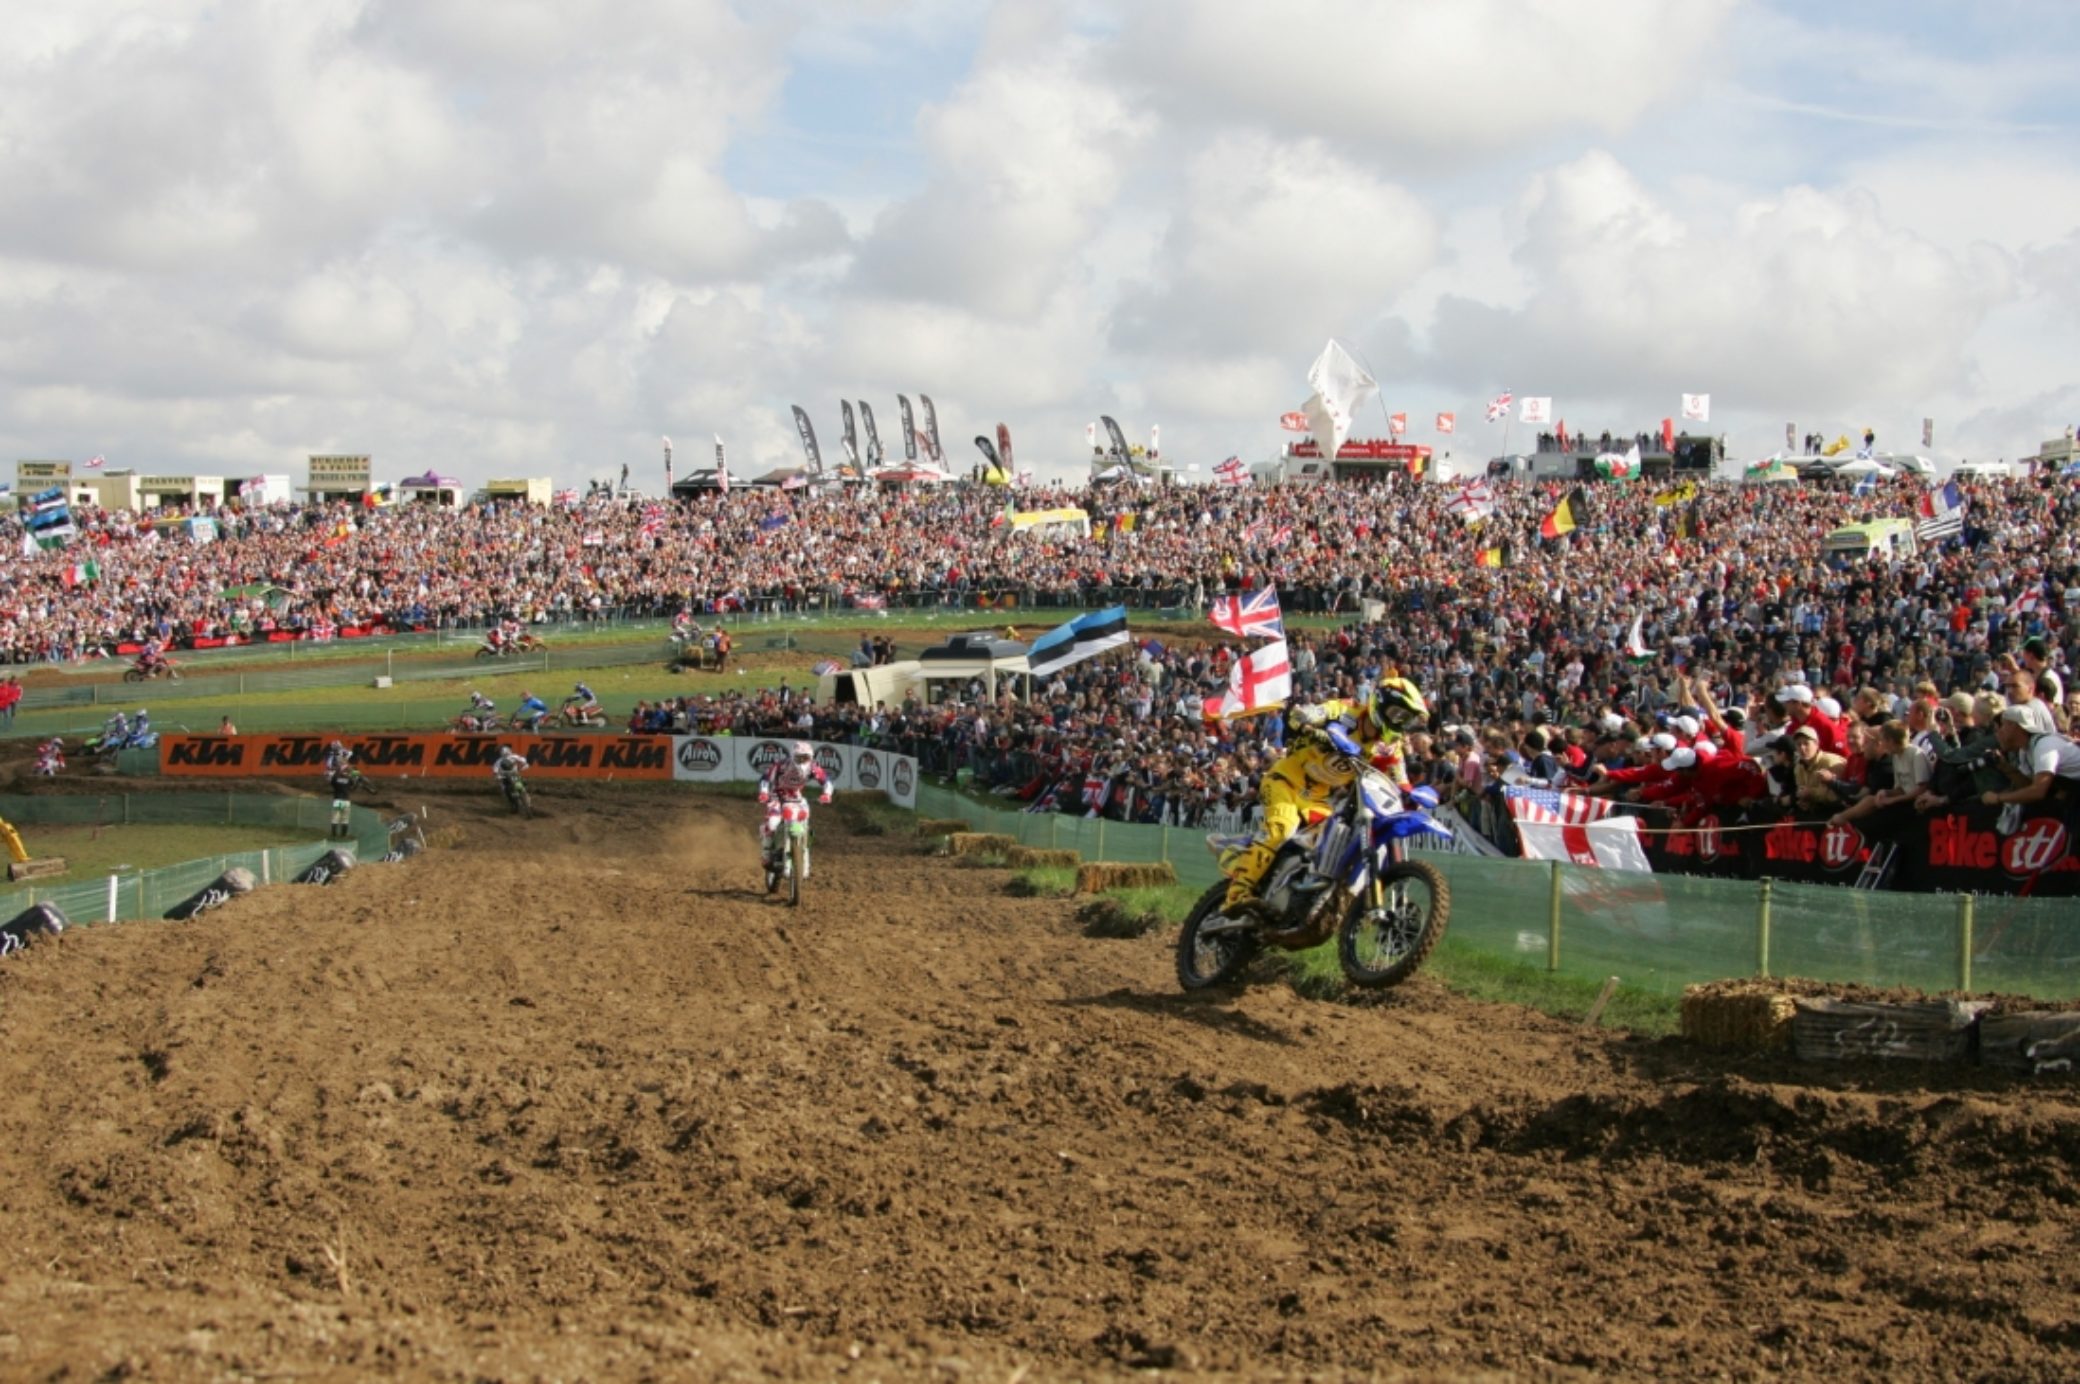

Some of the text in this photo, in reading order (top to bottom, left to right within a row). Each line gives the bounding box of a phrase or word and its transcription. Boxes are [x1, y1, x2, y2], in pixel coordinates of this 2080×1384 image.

[167, 736, 245, 765] KTM
[349, 736, 425, 766] KTM
[526, 737, 594, 767] KTM
[601, 738, 666, 769] KTM
[681, 743, 719, 763] Airoh
[1929, 814, 1998, 869] Bike
